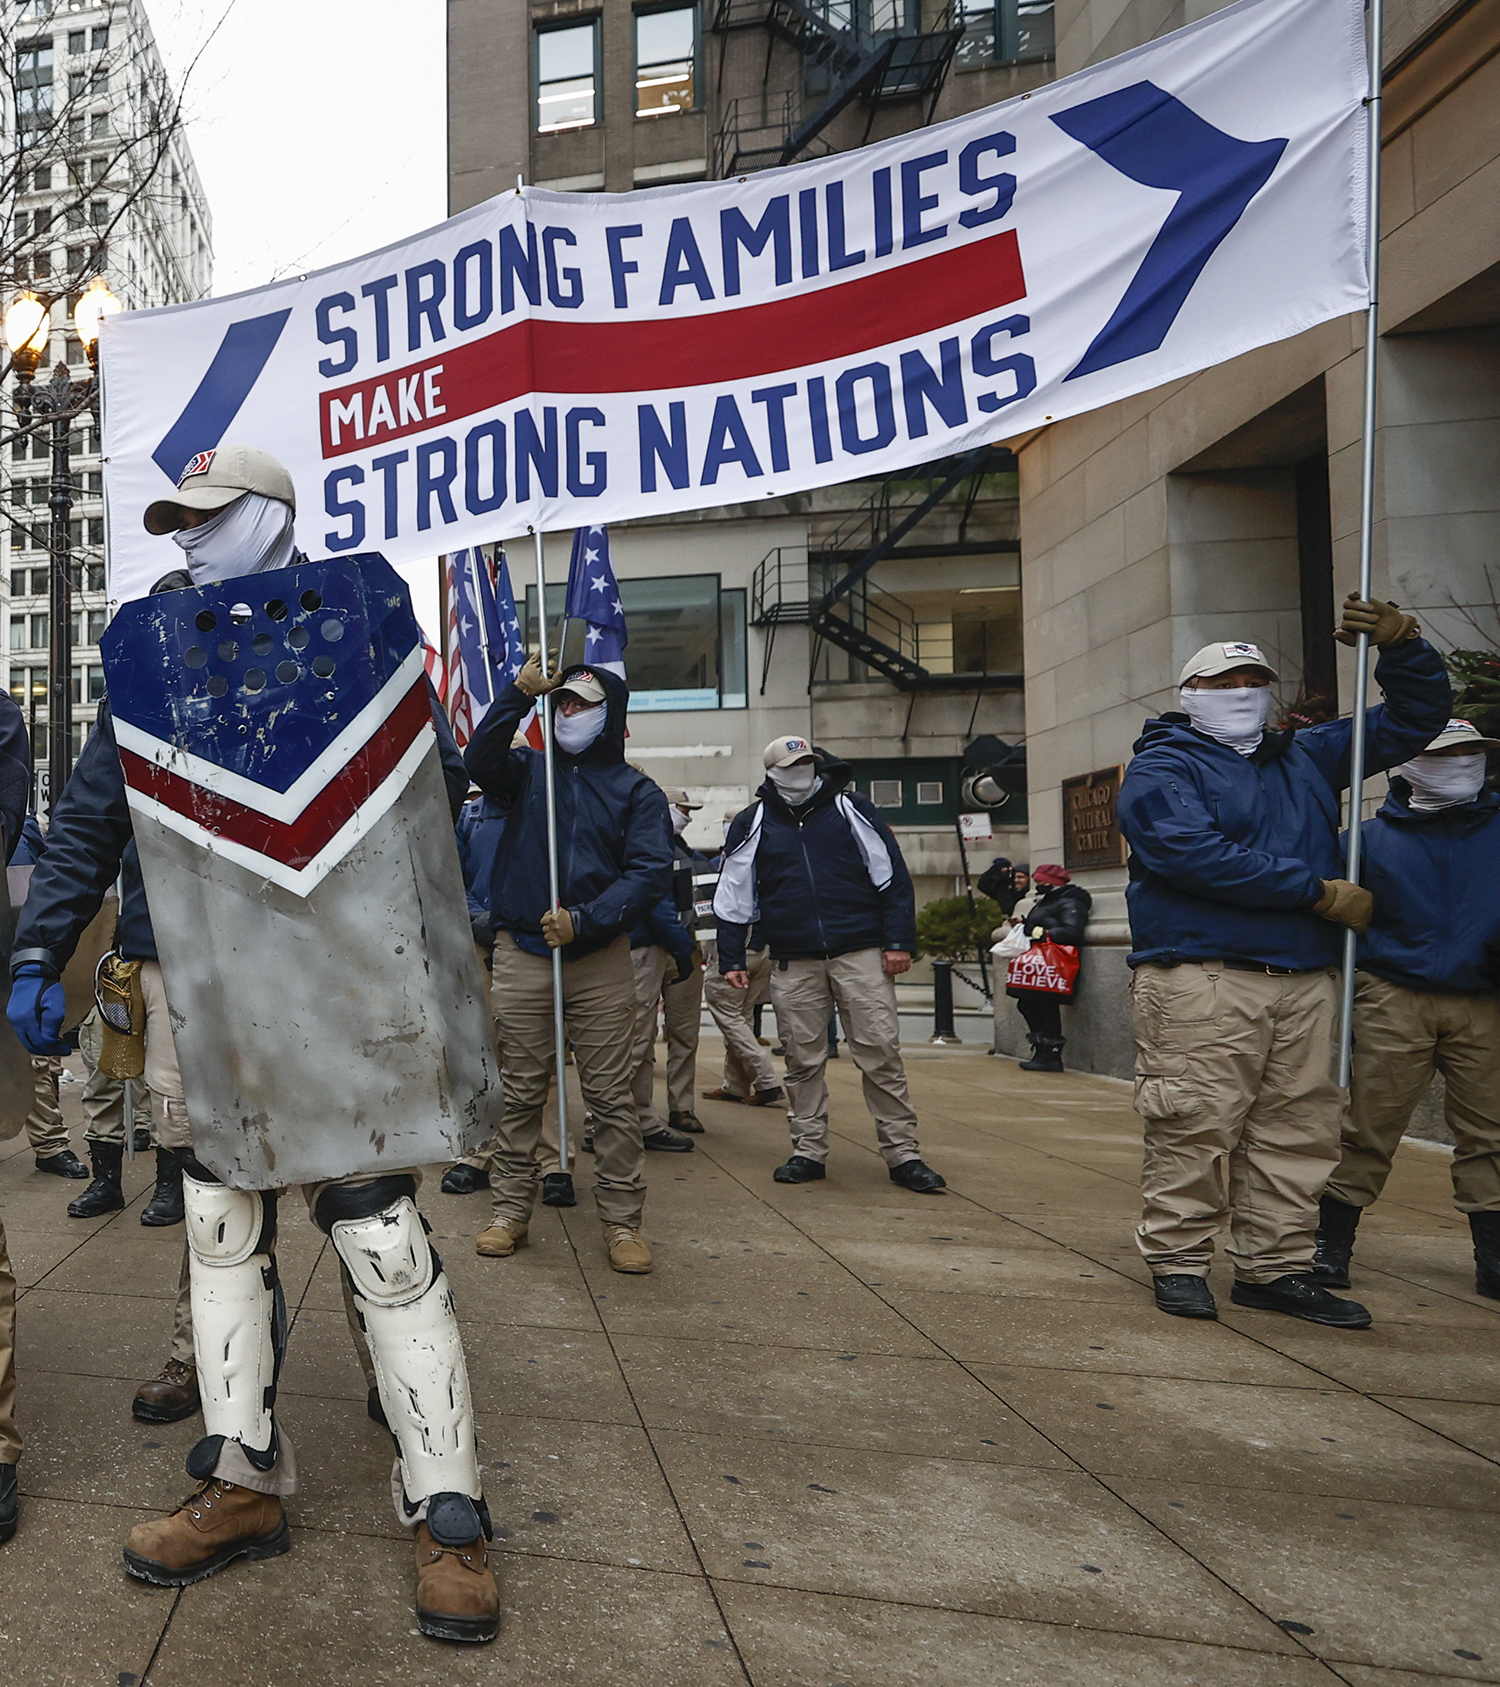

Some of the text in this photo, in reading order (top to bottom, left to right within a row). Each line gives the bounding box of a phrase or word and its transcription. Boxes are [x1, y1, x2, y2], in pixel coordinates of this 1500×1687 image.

[315, 130, 1017, 379] STRONG FAMILIES
[323, 313, 1038, 553] STRONG NATIONS
[329, 363, 447, 447] MAKE
